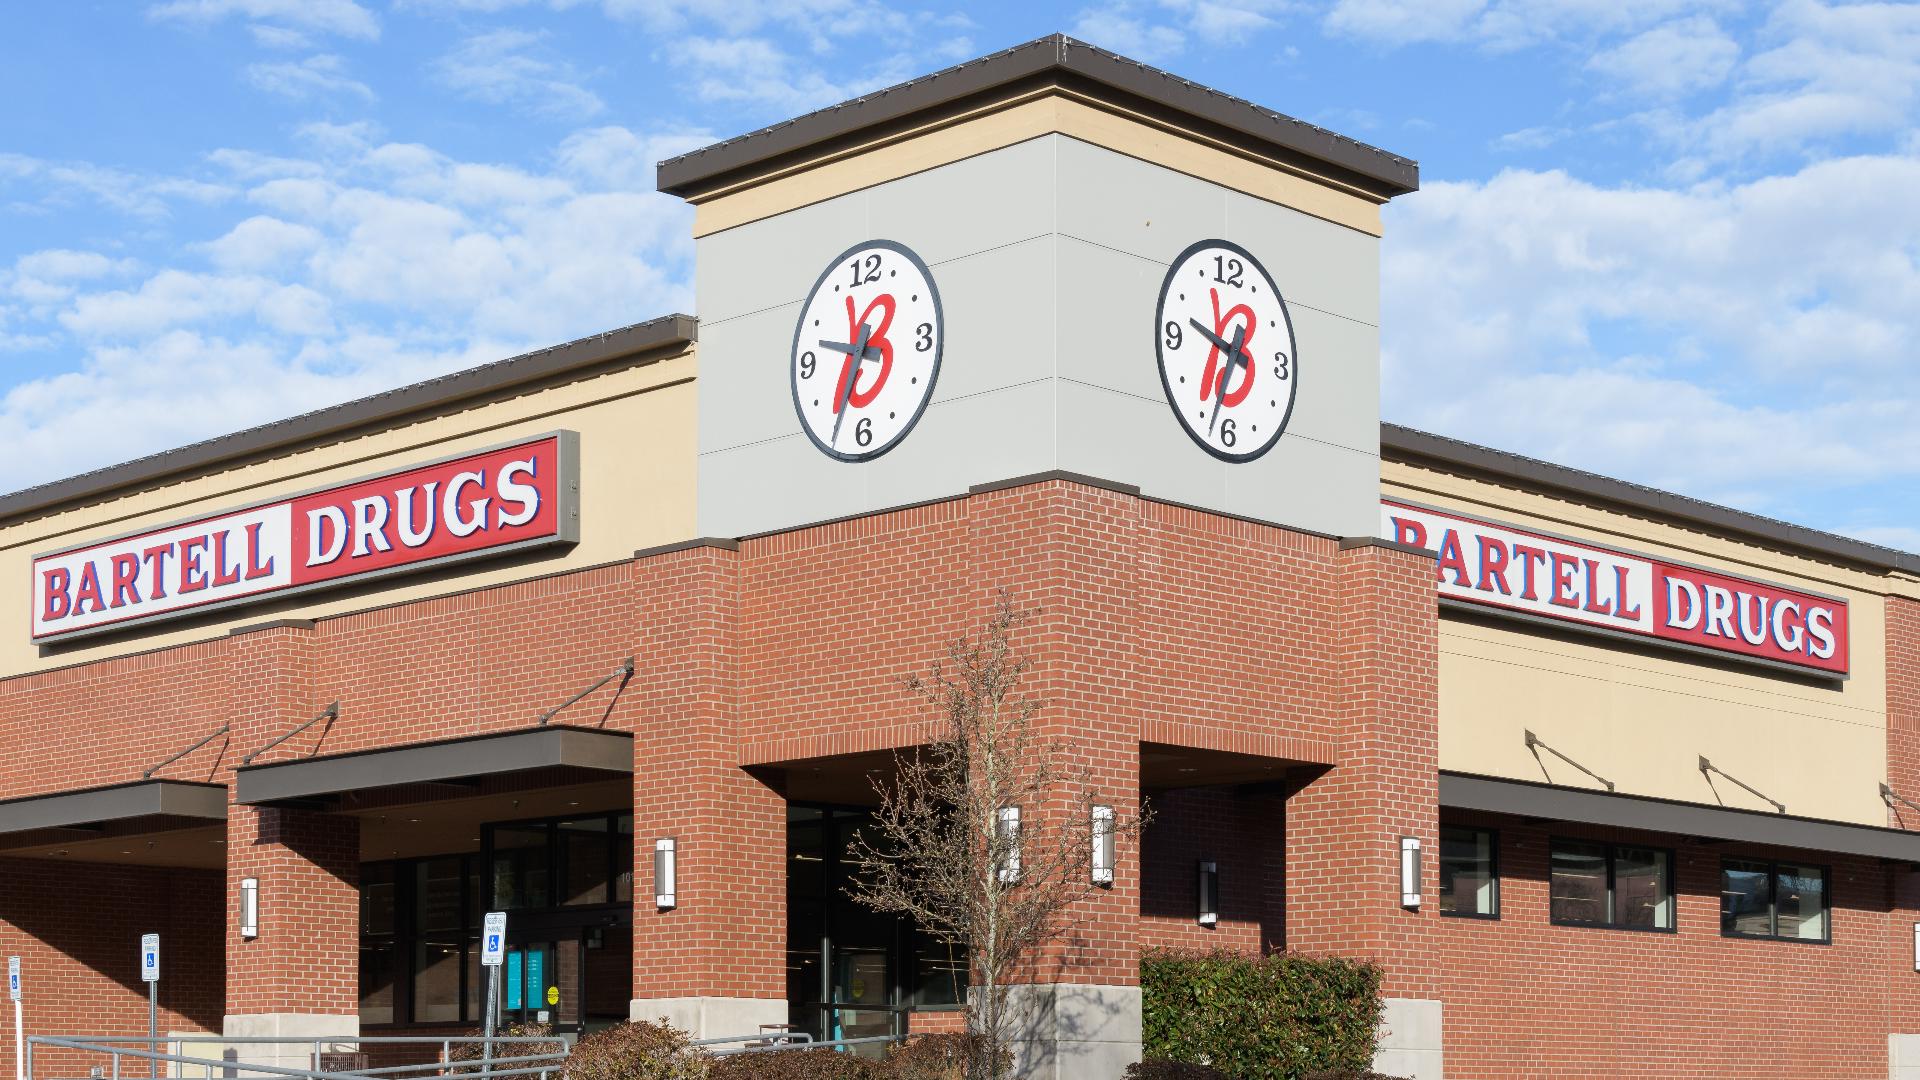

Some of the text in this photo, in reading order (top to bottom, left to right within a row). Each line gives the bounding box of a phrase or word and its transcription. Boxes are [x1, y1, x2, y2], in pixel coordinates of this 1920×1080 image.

[849, 253, 882, 288] 12
[1213, 255, 1244, 288] 12
[915, 322, 933, 352] 3
[1165, 320, 1183, 350] 9
[800, 351, 816, 379] 9
[833, 293, 896, 414] B
[1273, 352, 1289, 380] 3
[855, 417, 873, 447] 6
[1220, 418, 1237, 447] 6
[42, 456, 541, 621] BARTELL DRUGS
[1663, 575, 1836, 660] DRUGS
